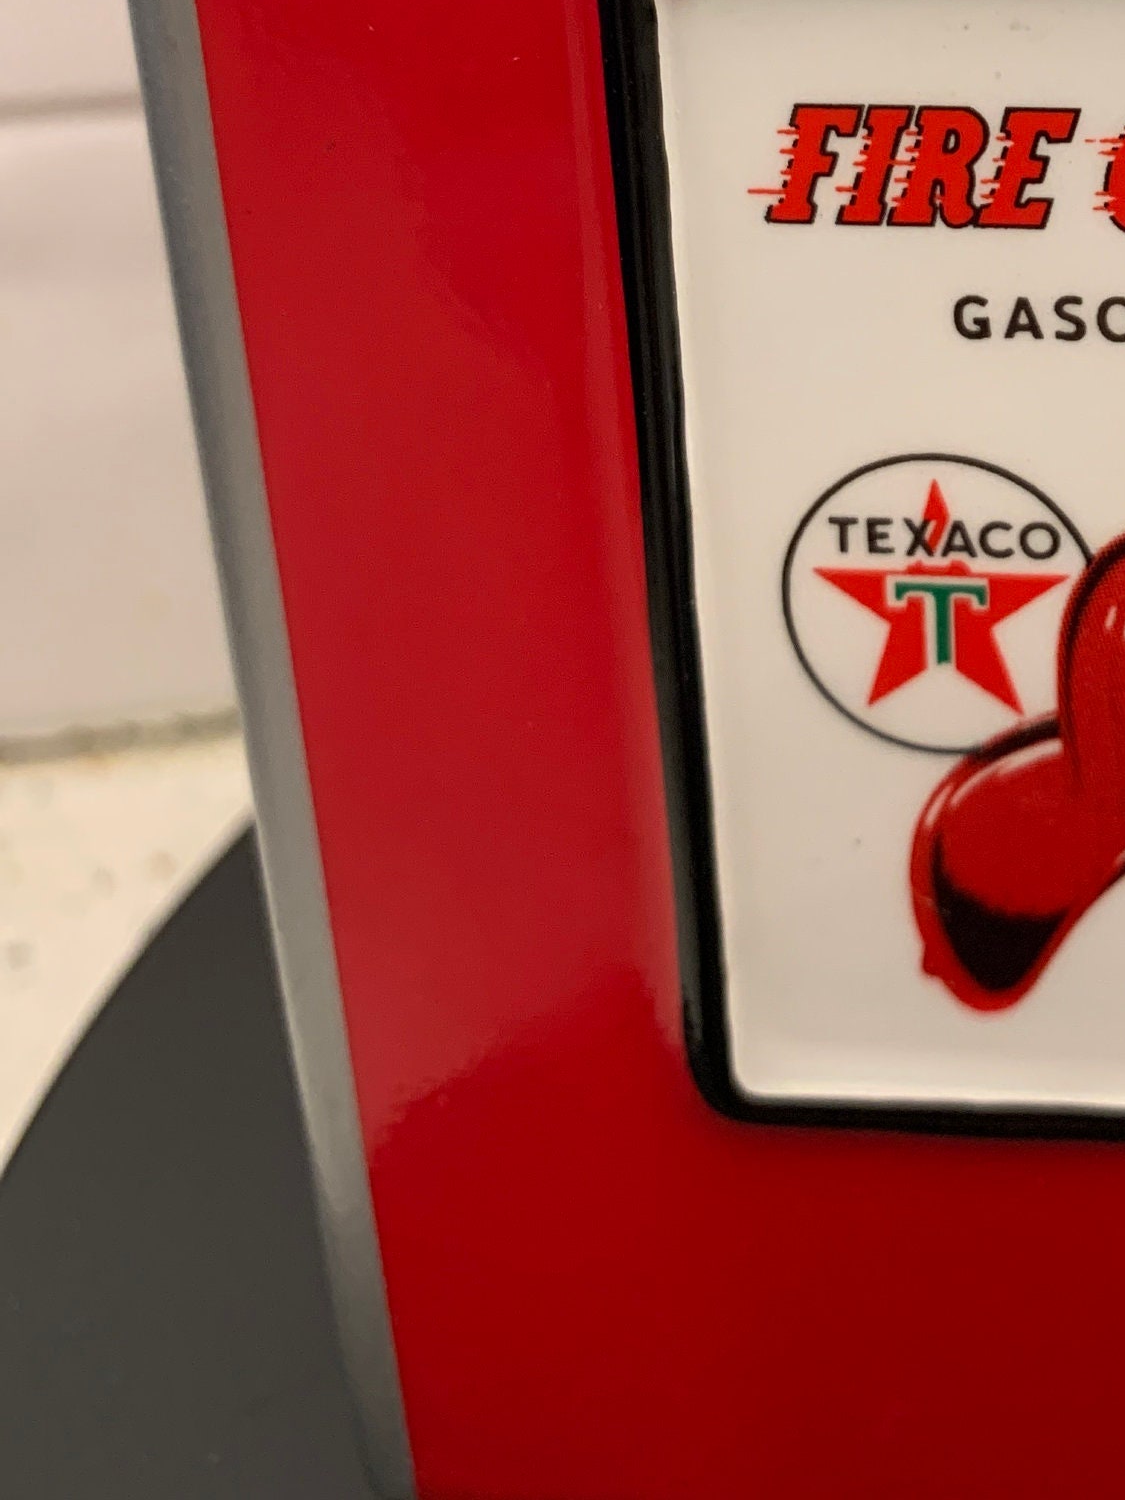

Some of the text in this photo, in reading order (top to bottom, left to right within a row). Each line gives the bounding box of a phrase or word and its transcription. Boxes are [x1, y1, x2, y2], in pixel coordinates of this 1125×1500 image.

[763, 103, 1081, 230] FIRE
[828, 515, 1061, 562] TEXACO
[889, 578, 990, 667] T
